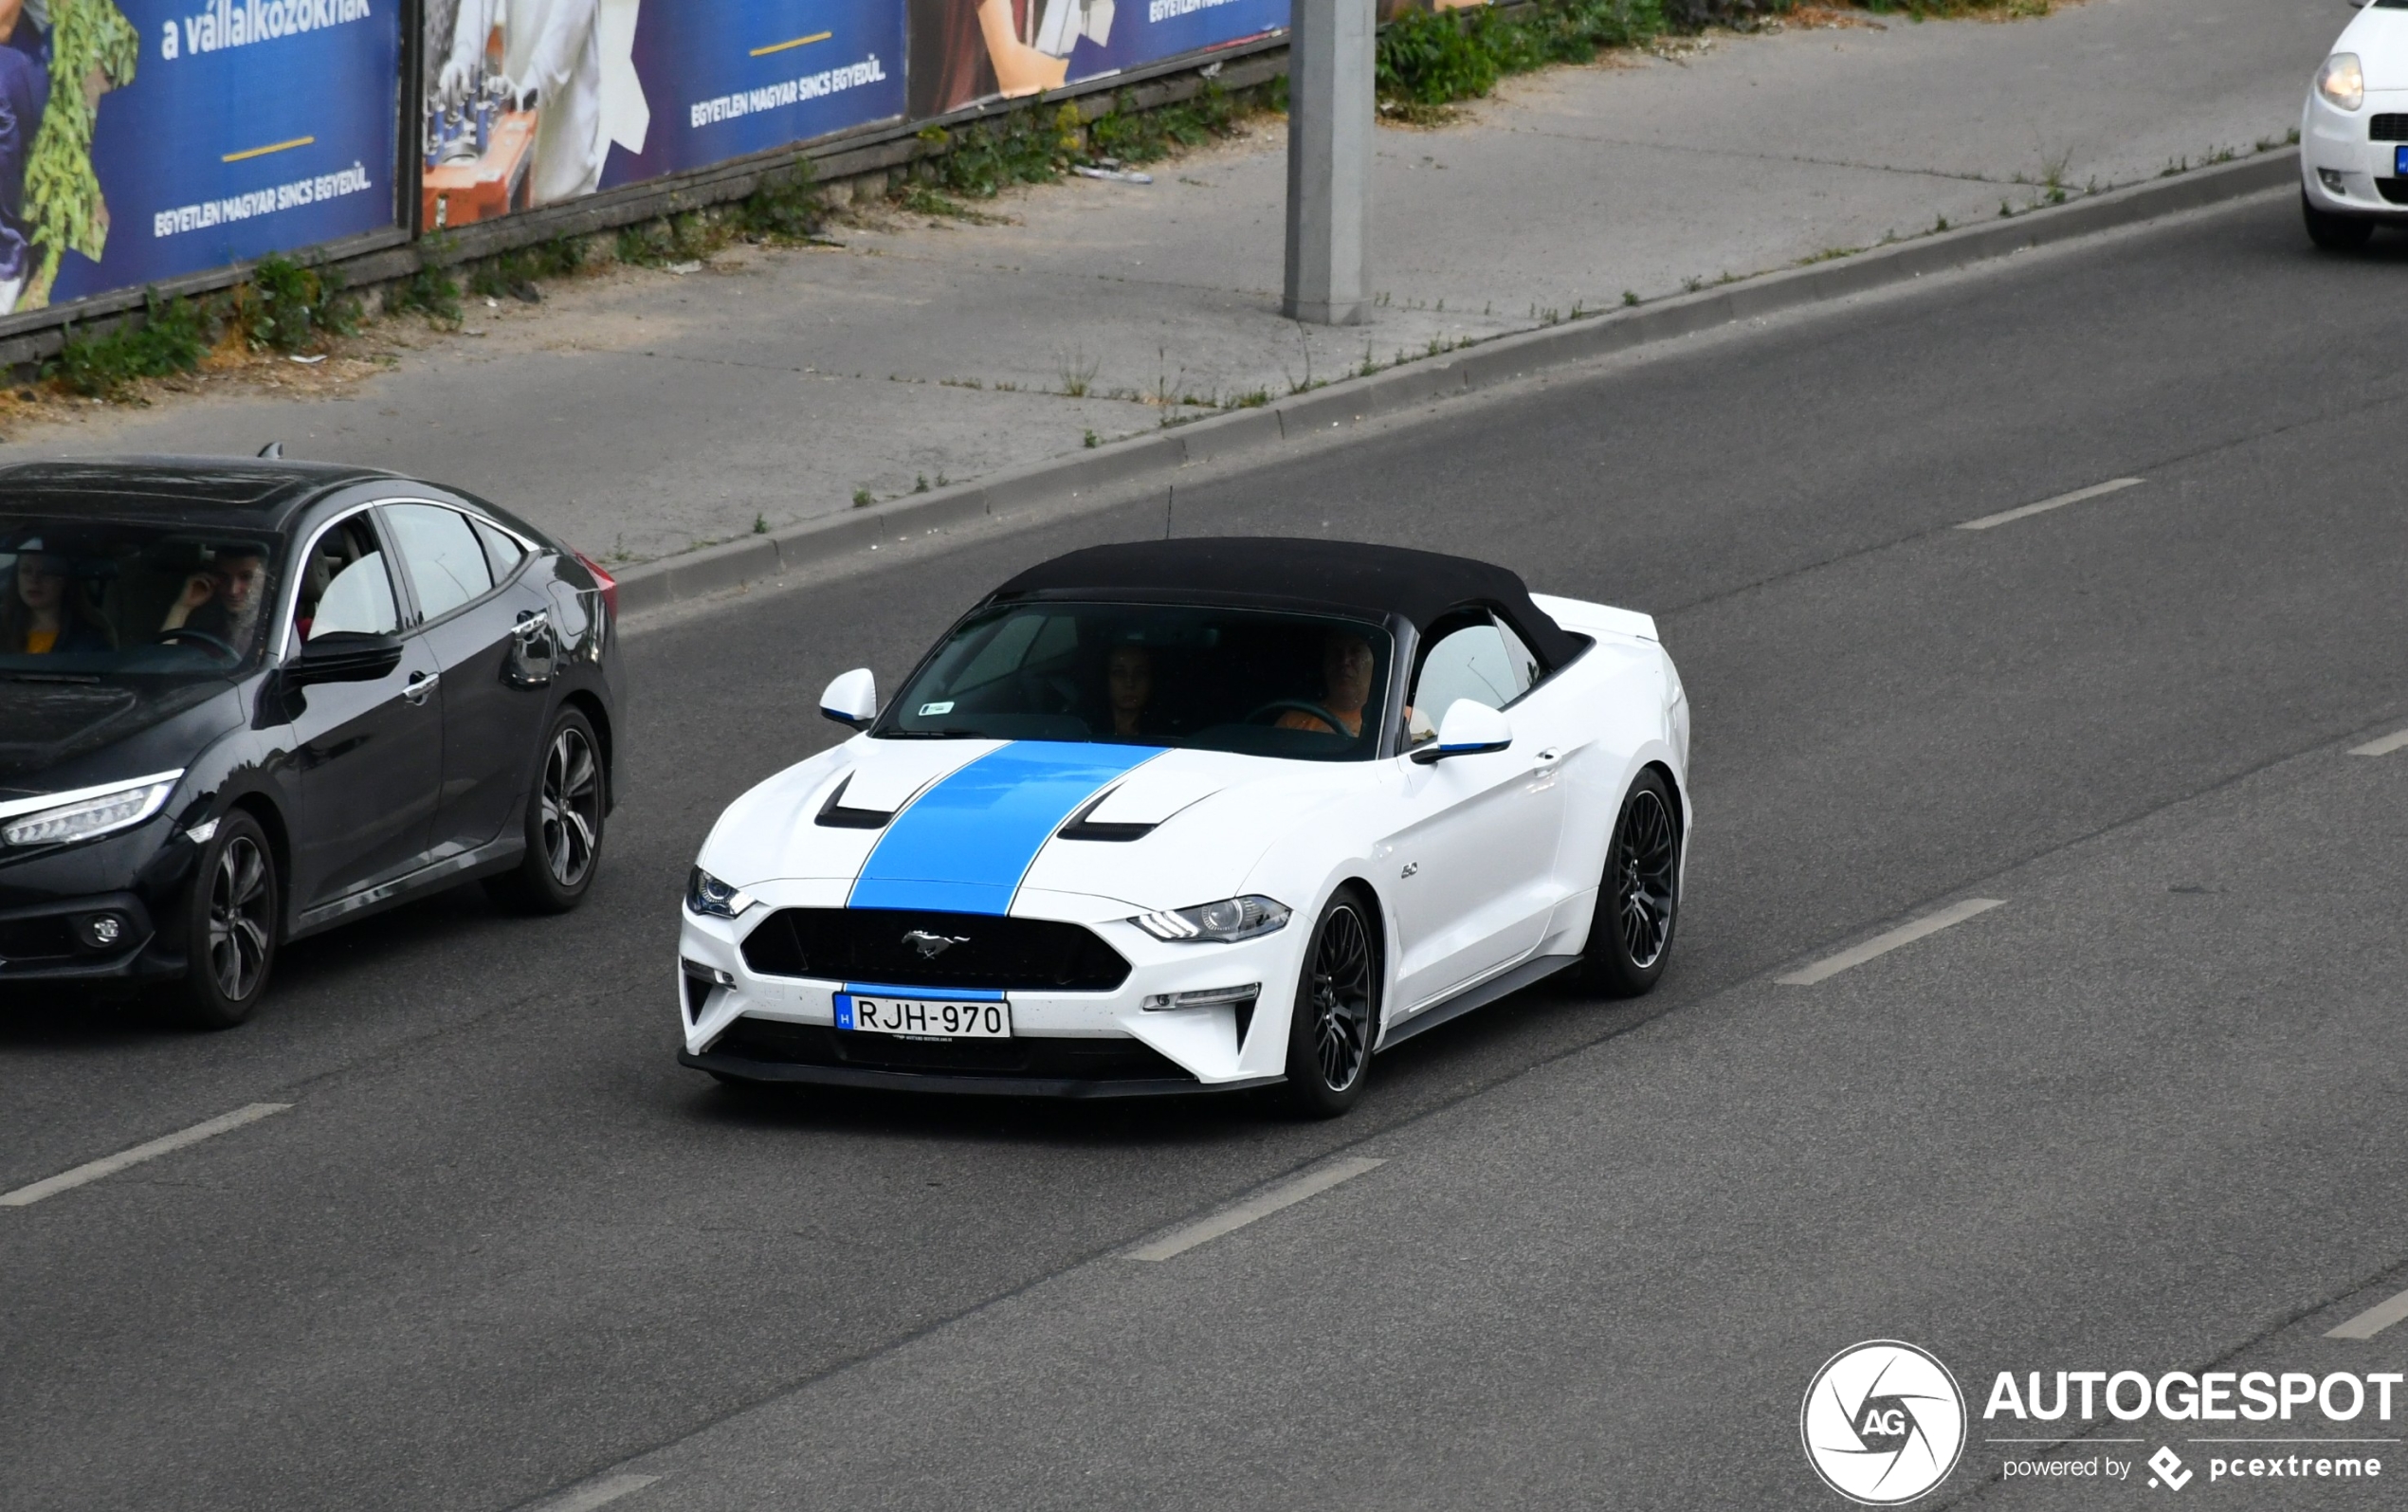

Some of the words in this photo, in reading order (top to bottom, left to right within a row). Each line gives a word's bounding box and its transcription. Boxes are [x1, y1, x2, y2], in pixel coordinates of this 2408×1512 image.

[161, 19, 178, 60] a
[690, 92, 748, 128] EGYETLEN
[749, 80, 797, 113] MAGYAR
[799, 71, 831, 101] SINCS
[154, 199, 221, 237] EGYETLEN
[222, 187, 276, 223] MAGYAR
[277, 177, 314, 210] SINCS
[841, 1013, 849, 1025] H
[858, 1000, 1002, 1033] RJH-970
